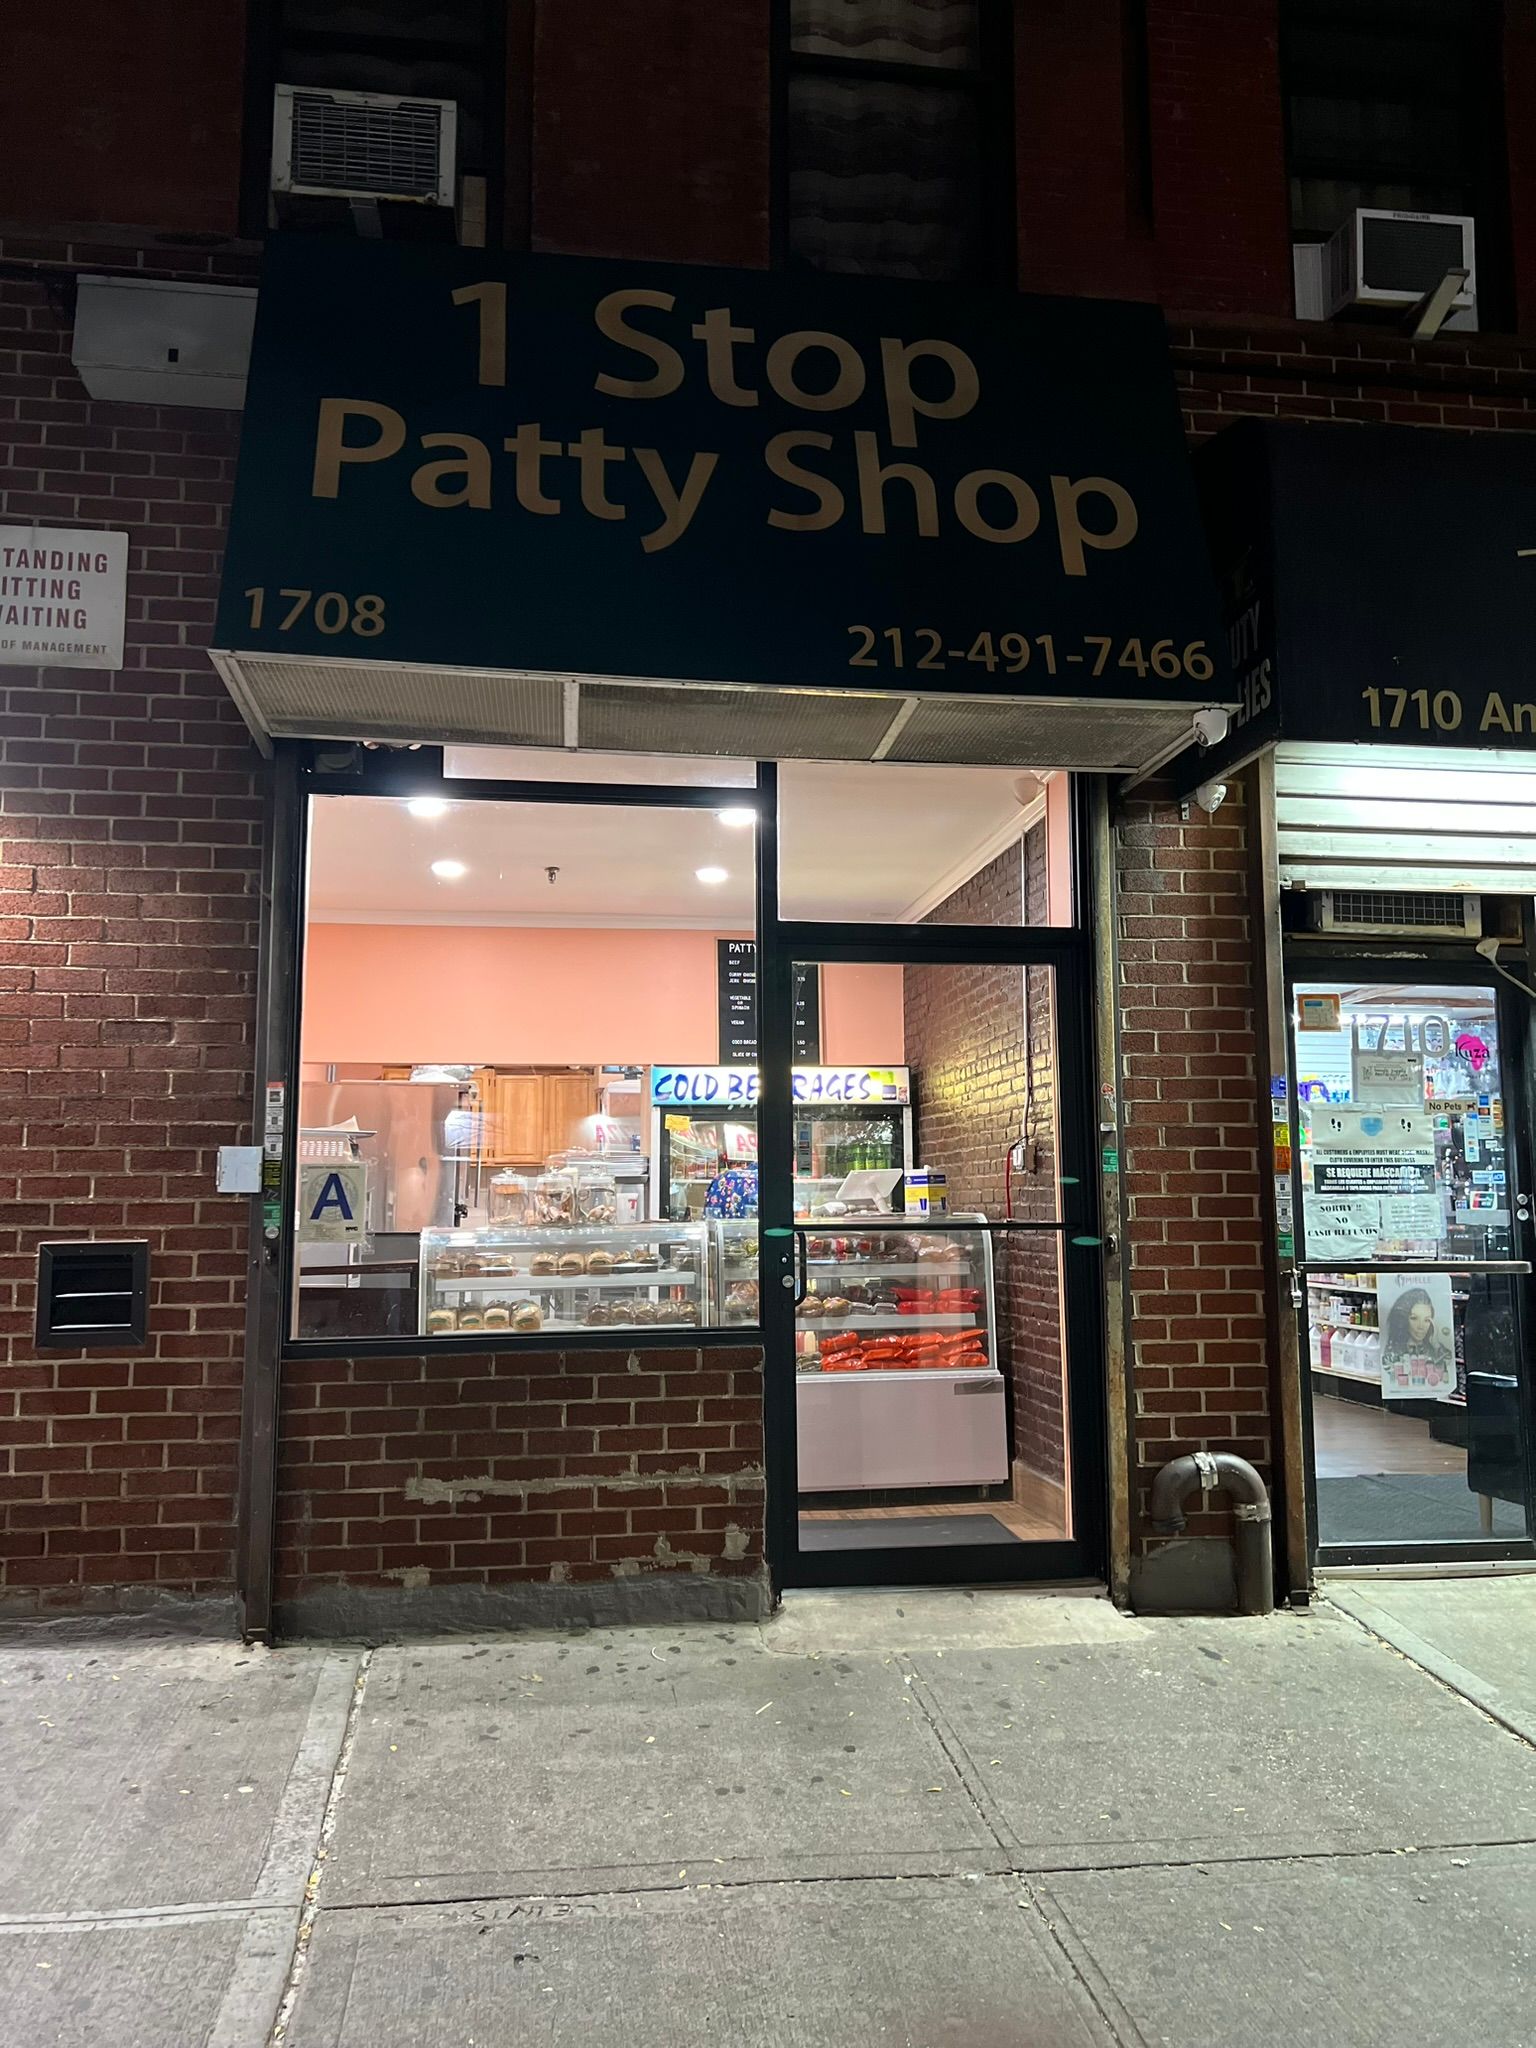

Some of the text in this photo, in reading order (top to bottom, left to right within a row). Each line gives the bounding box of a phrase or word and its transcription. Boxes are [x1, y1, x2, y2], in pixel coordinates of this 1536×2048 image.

[451, 282, 981, 448] 1 Stop
[311, 396, 1139, 576] Patty Shop
[3, 547, 109, 574] TANDING
[0, 575, 81, 600] ITTING
[242, 587, 387, 637] 1708
[22, 640, 107, 655] MANAGEMENT
[847, 624, 1215, 681] 212-491-7466
[1361, 687, 1463, 731] 1710
[1351, 1014, 1451, 1058] 1710
[654, 1073, 873, 1101] COLD BERAGES
[1429, 1103, 1462, 1111] No Pets
[1326, 1168, 1336, 1178] SE
[1337, 1168, 1372, 1179] REQUIERE
[310, 1172, 353, 1220] A
[1319, 1204, 1352, 1213] SORRY
[1308, 1228, 1378, 1237] CASH REFUNDS
